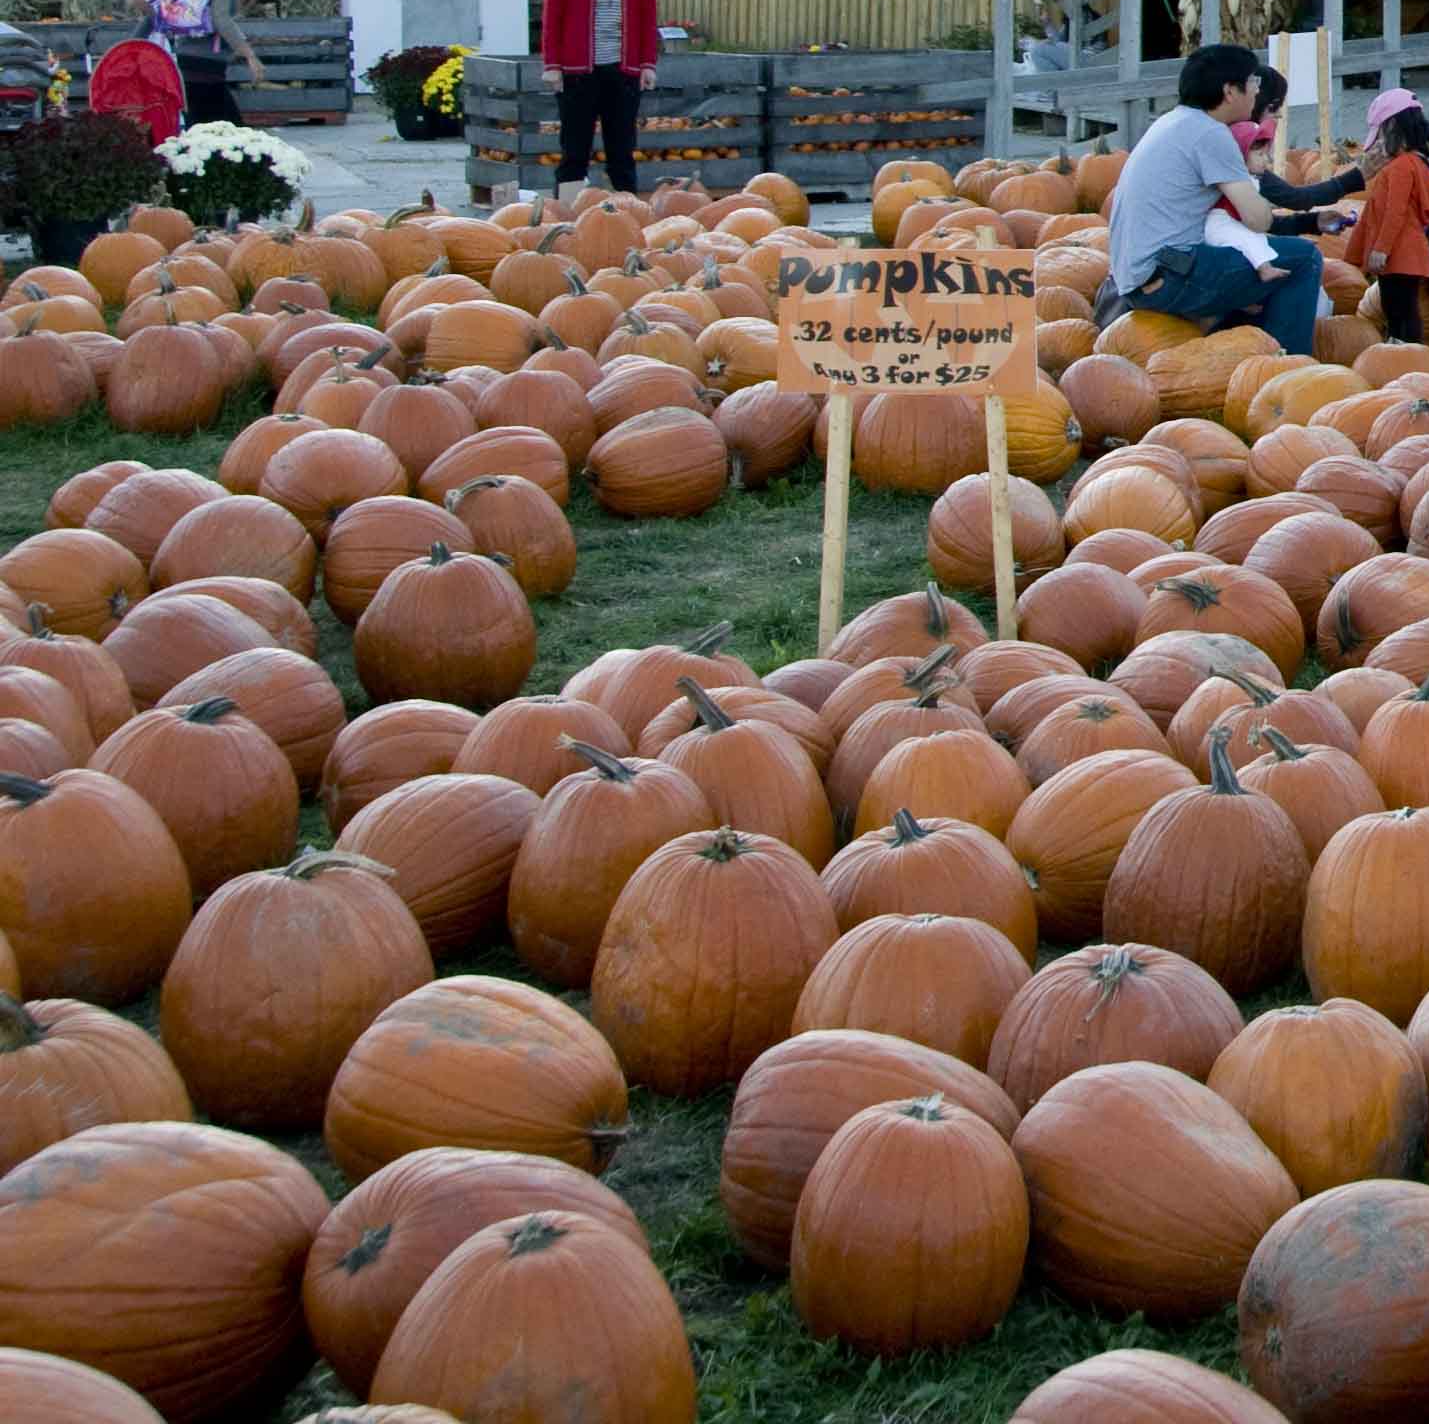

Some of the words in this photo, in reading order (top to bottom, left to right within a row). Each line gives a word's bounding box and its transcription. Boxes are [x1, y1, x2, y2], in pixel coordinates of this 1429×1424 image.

[777, 251, 1036, 307] Pumpkins
[793, 320, 833, 343] .32
[844, 320, 1014, 349] cents/pound
[898, 352, 921, 365] or
[861, 366, 881, 384] 3
[886, 364, 930, 385] for
[935, 363, 992, 386] $25
